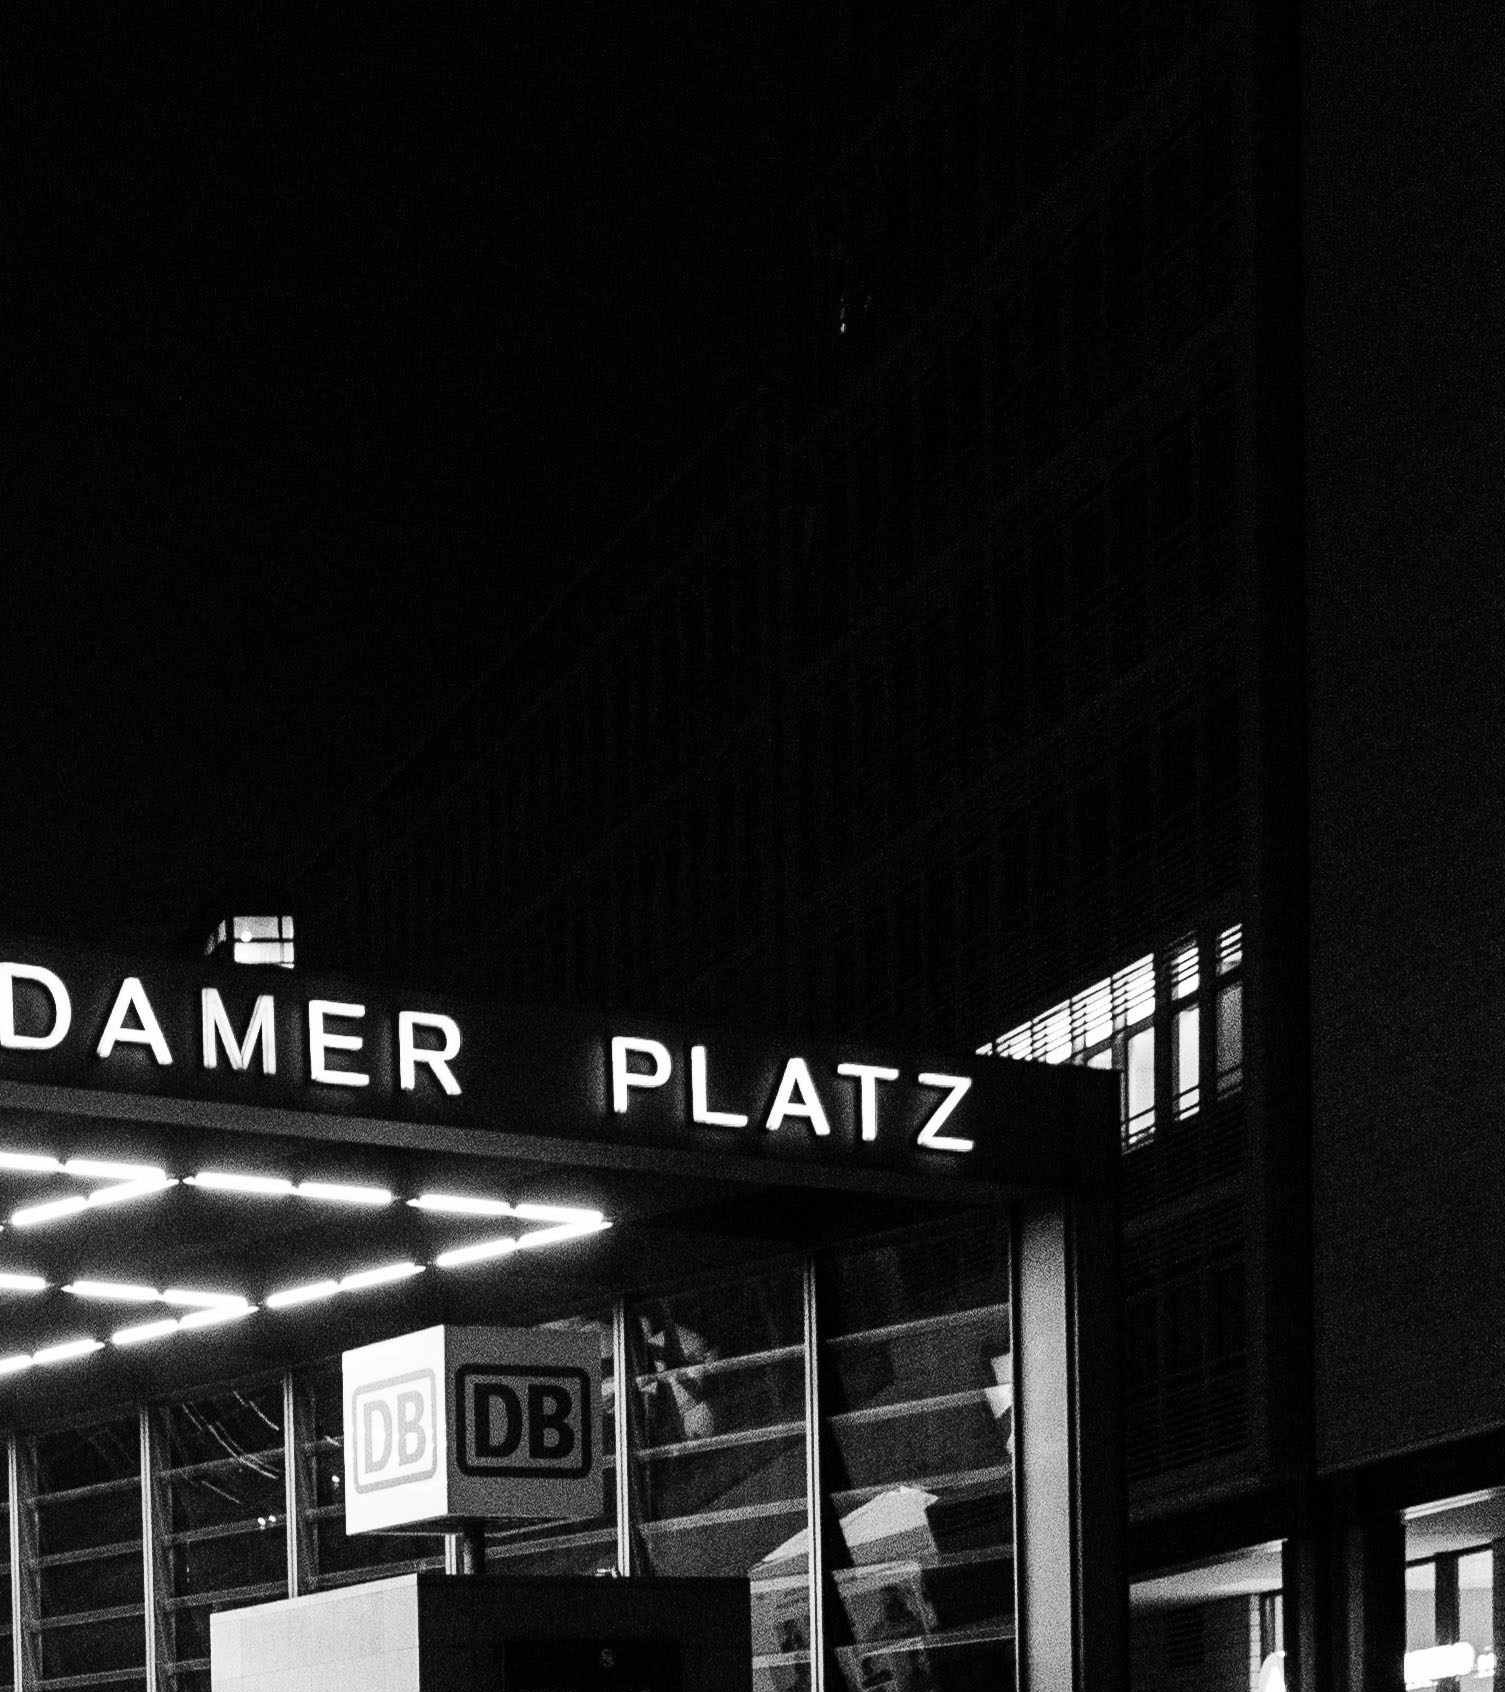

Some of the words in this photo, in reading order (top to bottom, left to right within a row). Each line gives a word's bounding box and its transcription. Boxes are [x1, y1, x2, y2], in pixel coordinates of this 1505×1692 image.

[611, 1036, 975, 1152] PLATZ
[363, 1390, 427, 1474] DB
[473, 1382, 576, 1460] DB
